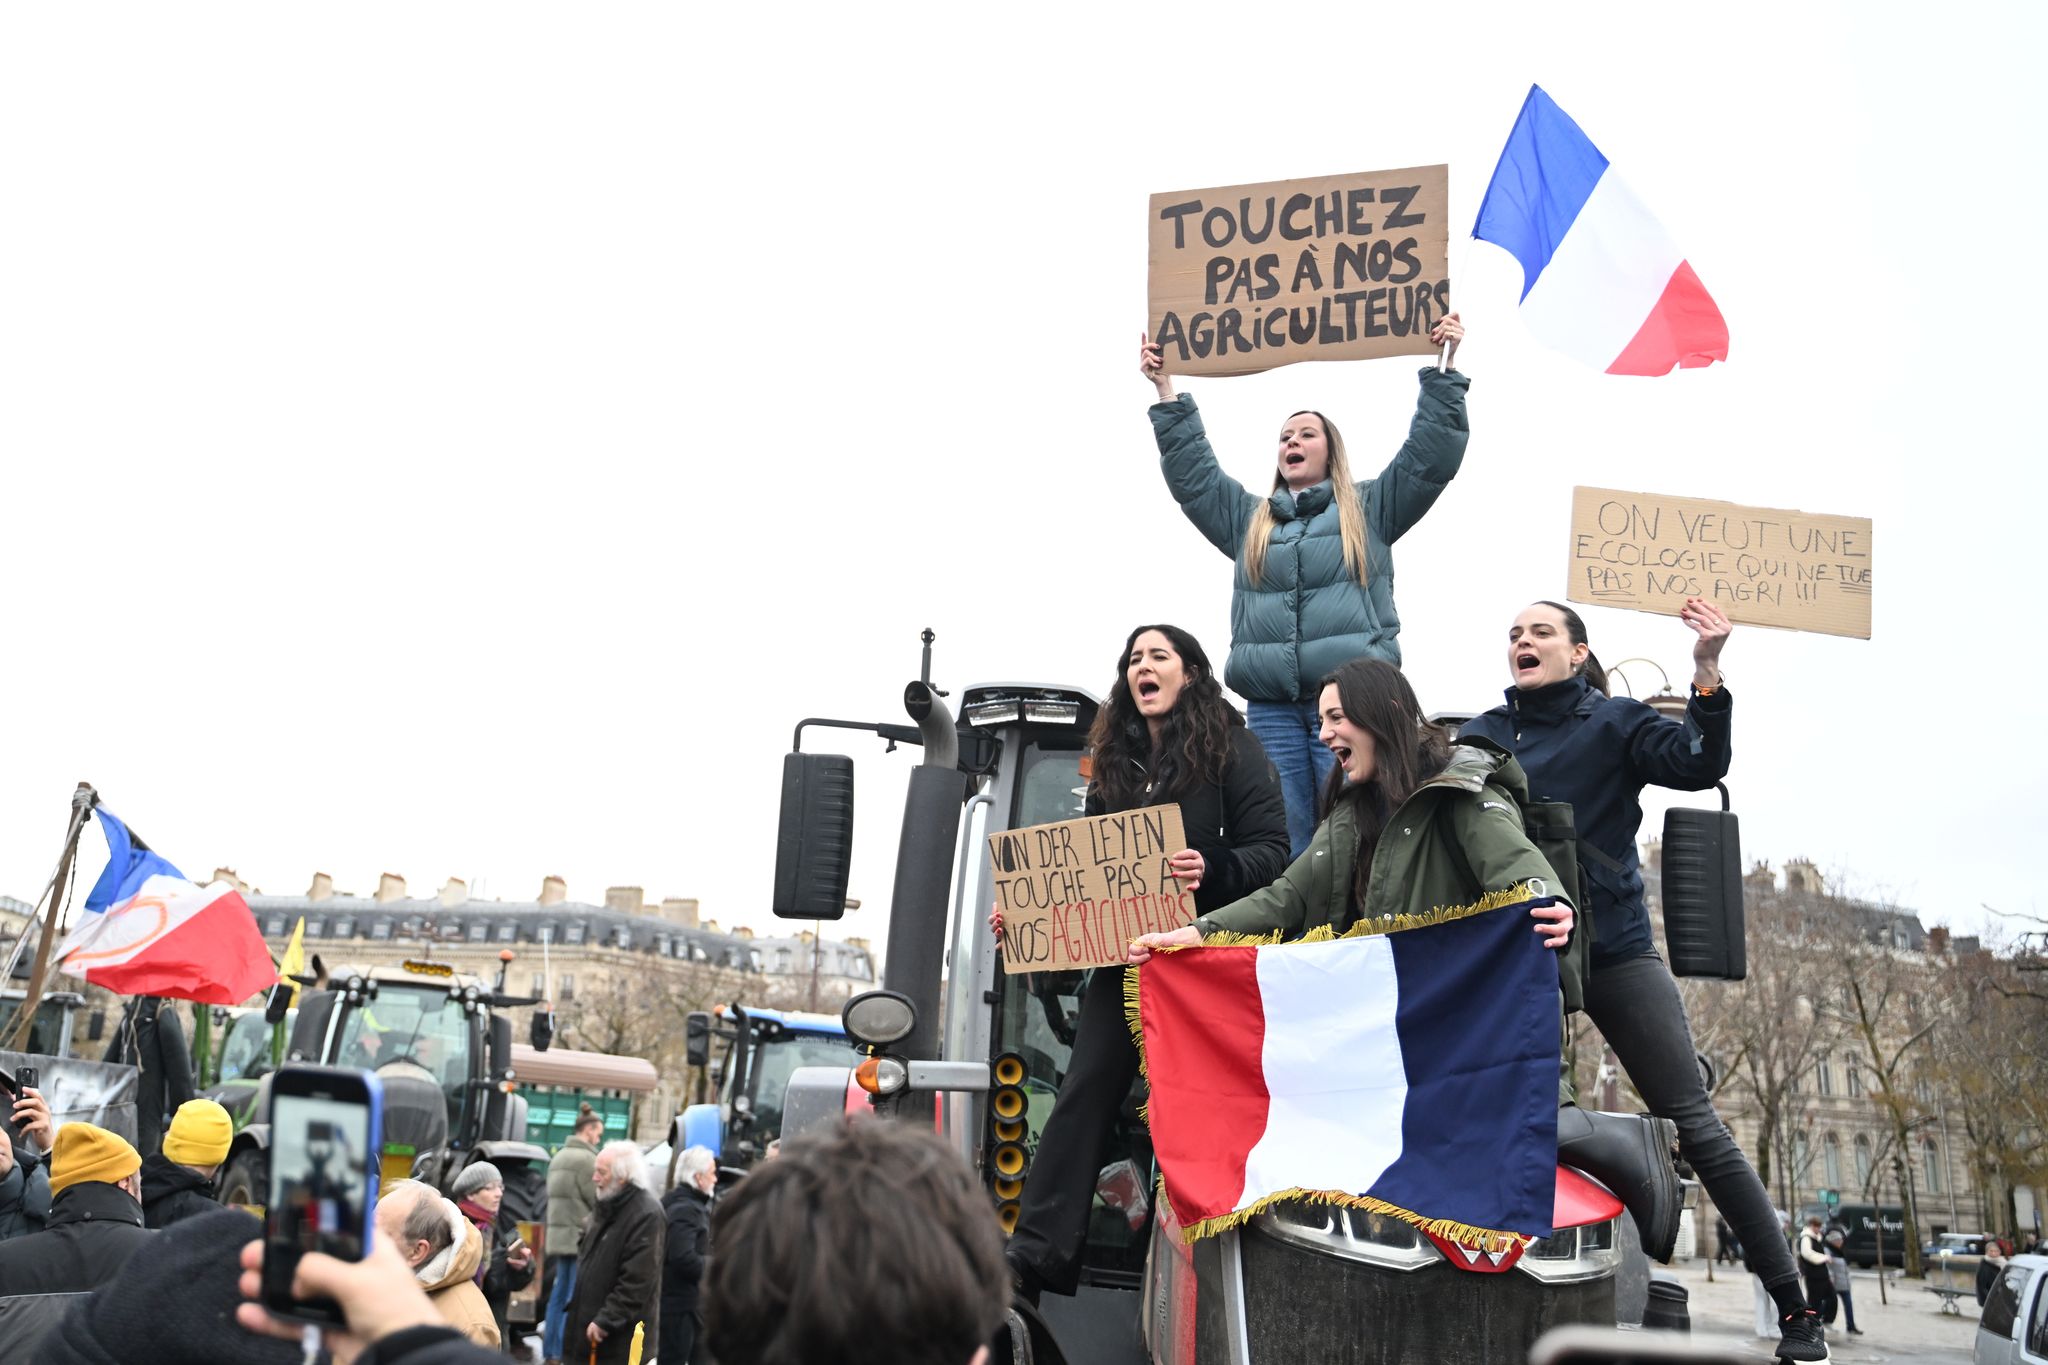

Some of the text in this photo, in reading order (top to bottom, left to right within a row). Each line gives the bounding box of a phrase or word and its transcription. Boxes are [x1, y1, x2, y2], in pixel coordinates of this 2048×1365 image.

[1160, 185, 1426, 249] TOUCHEZ
[1205, 237, 1422, 304] PAS À NOS
[1599, 501, 1866, 557] ON VEUT UNE
[1576, 534, 1729, 574] ECOLOGIE
[1797, 559, 1833, 581] NE
[1835, 564, 1872, 584] TUE
[1587, 565, 1633, 589] PAS
[1647, 571, 1702, 596] NOS
[1714, 579, 1782, 606] AGRI
[1036, 826, 1079, 868] DER
[1089, 810, 1165, 866] LEYEN
[996, 857, 1180, 910] TOUCHE PAS A
[1001, 918, 1050, 964] NOS
